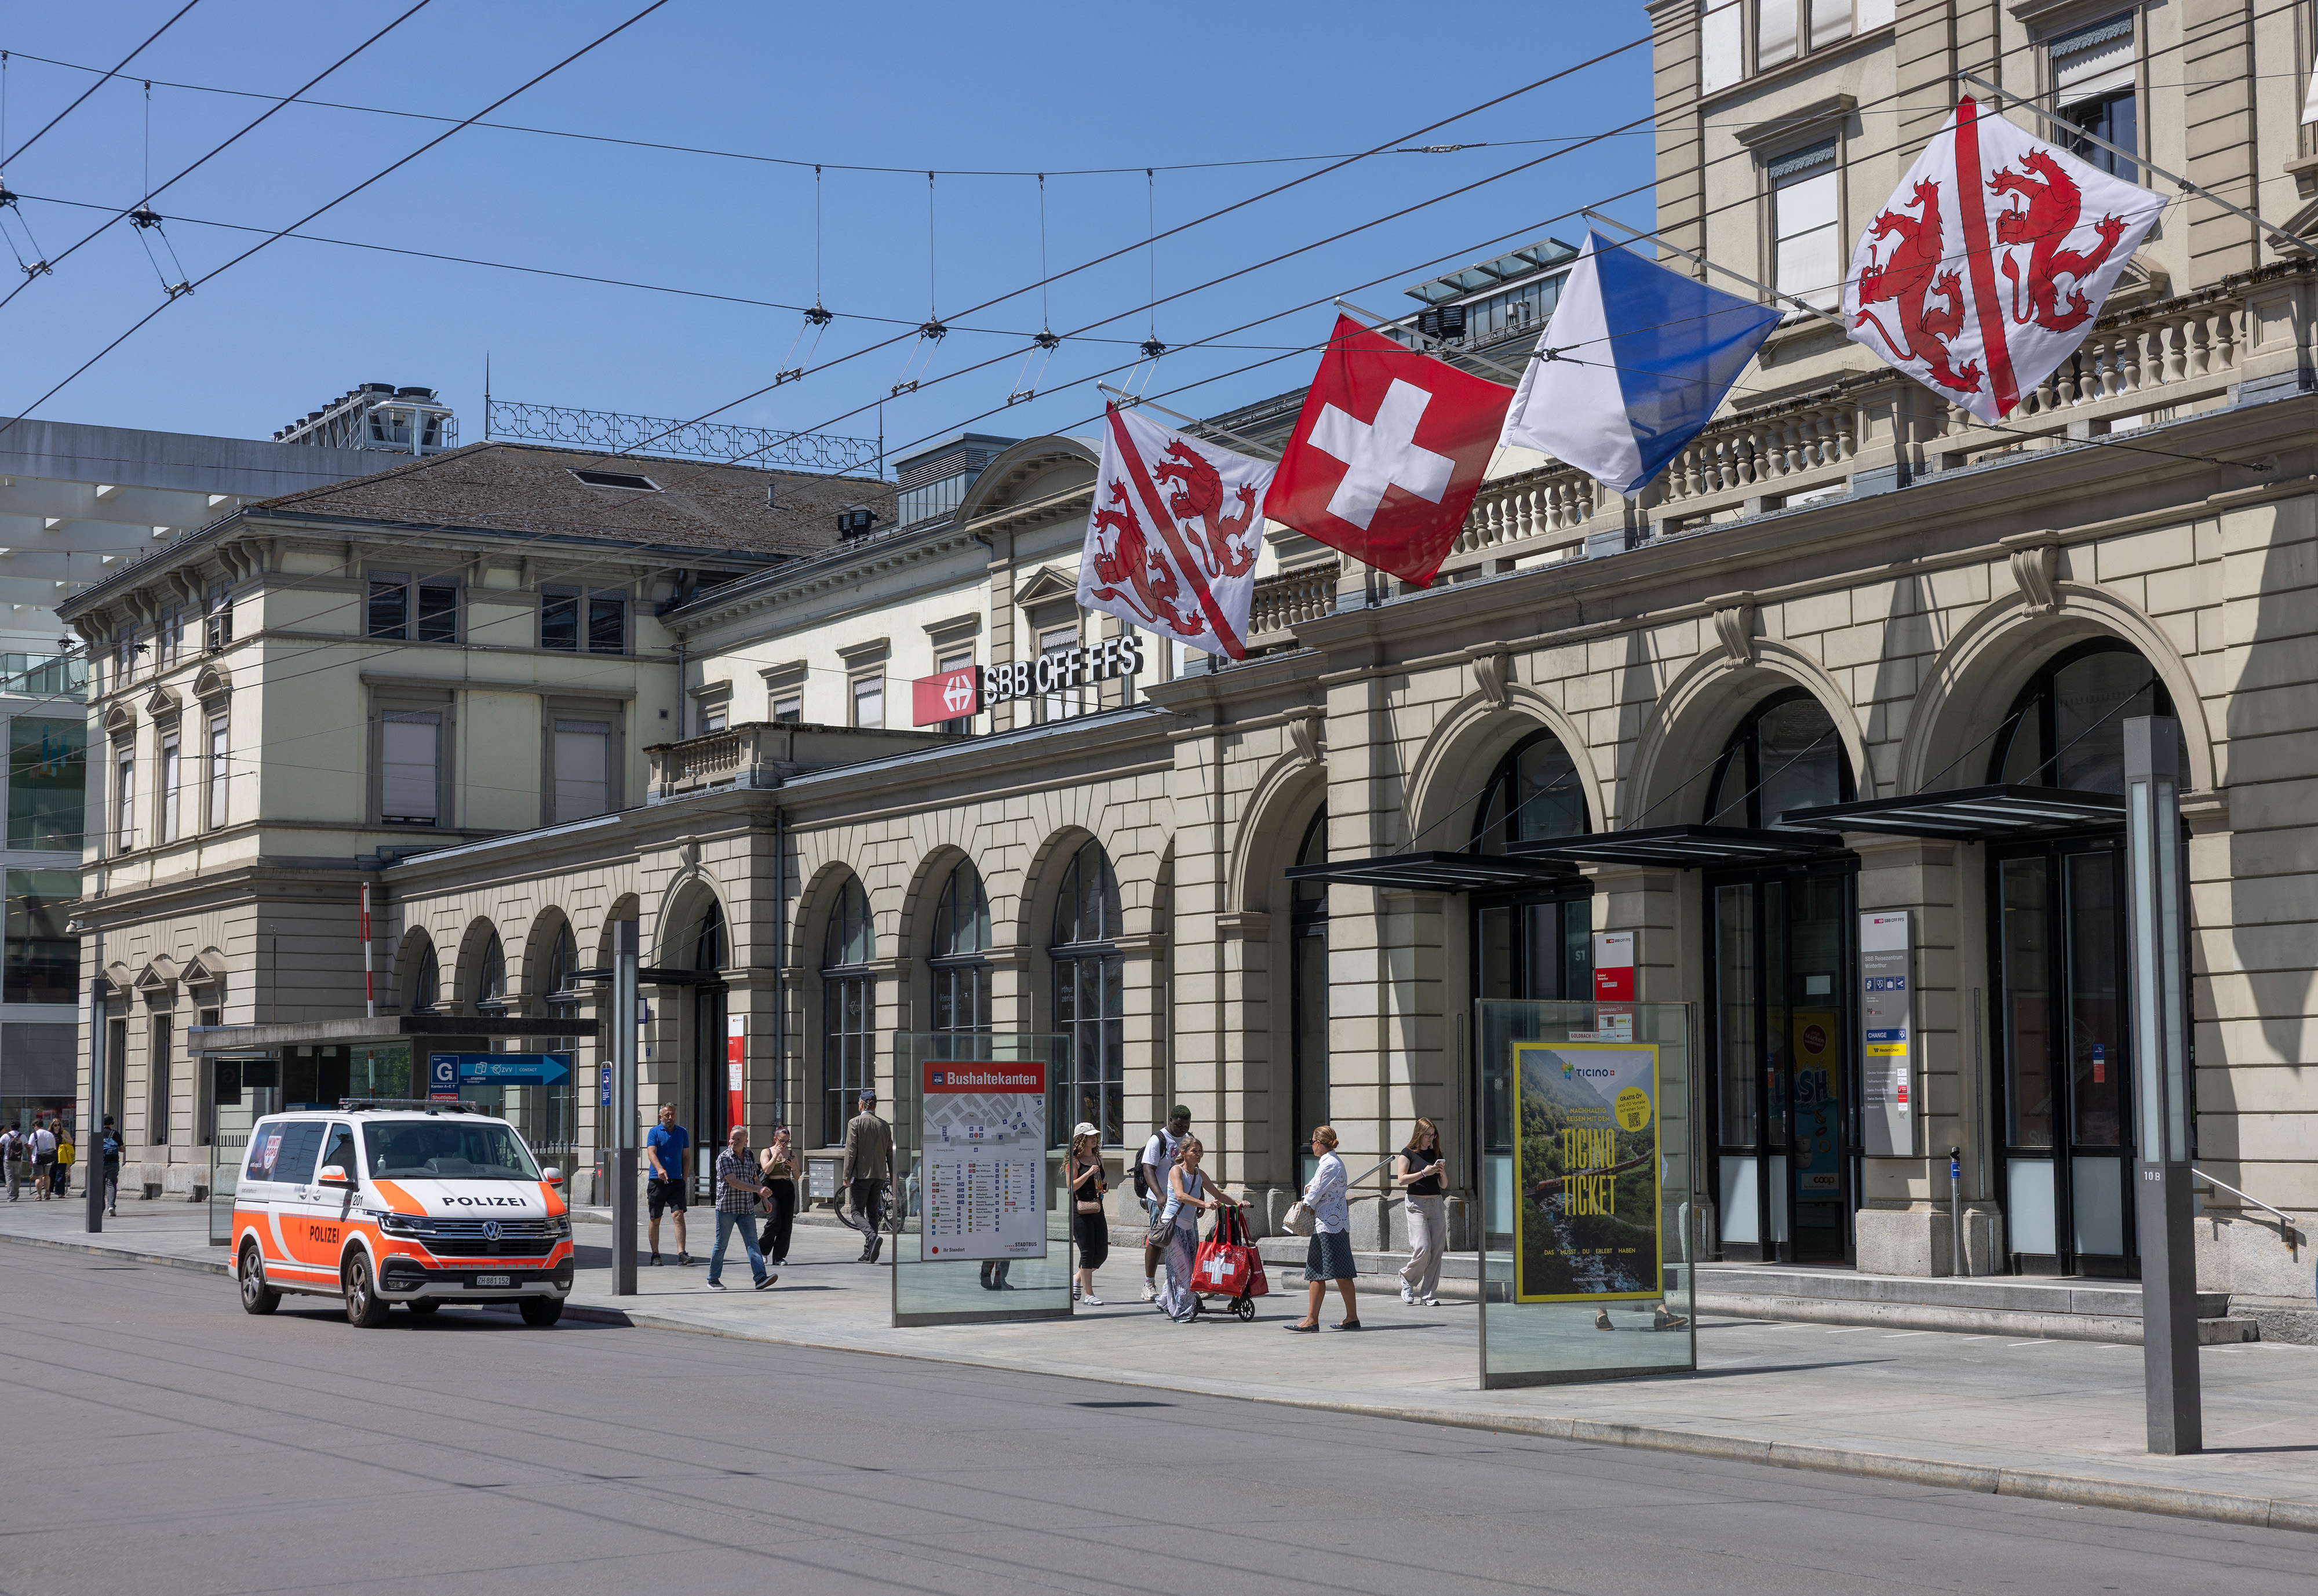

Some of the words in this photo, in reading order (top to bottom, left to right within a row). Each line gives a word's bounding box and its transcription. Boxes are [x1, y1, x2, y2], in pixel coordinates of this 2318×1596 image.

[985, 661, 1031, 704] SBB
[1036, 648, 1084, 693] CFF
[1089, 635, 1140, 680] FFS
[1805, 1033, 1824, 1043] Marken
[436, 1063, 453, 1081] G
[947, 1072, 1037, 1085] Bushaltekanten
[268, 1138, 280, 1146] WINTI
[1561, 1128, 1615, 1168] TICINO
[265, 1147, 277, 1157] COPS
[2144, 1171, 2153, 1180] 10
[2155, 1172, 2160, 1181] B
[353, 1195, 363, 1206] 201
[1561, 1175, 1617, 1215] TICKET
[442, 1197, 527, 1207] POLIZEI
[310, 1225, 340, 1244] POLIZEI
